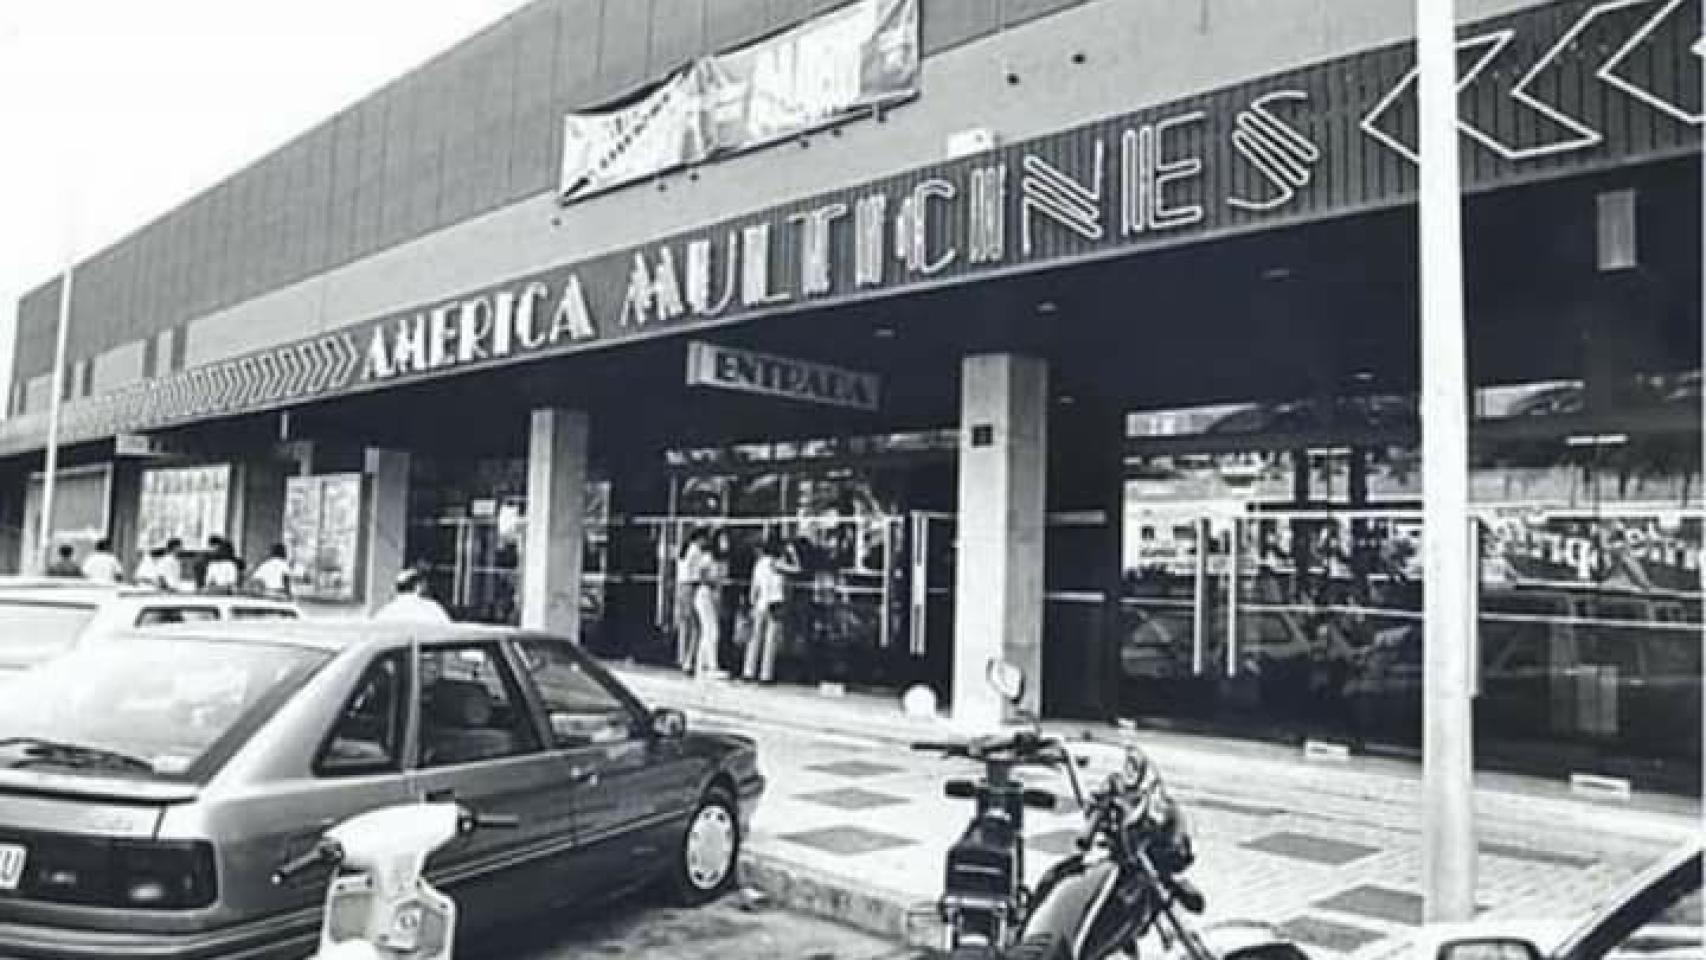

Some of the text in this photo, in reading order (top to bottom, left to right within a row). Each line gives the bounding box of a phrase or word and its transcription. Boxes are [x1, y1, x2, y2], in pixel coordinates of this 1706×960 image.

[361, 273, 594, 381] AMERICA
[620, 91, 1319, 325] MULTICINES
[715, 351, 877, 406] ENTRADA
